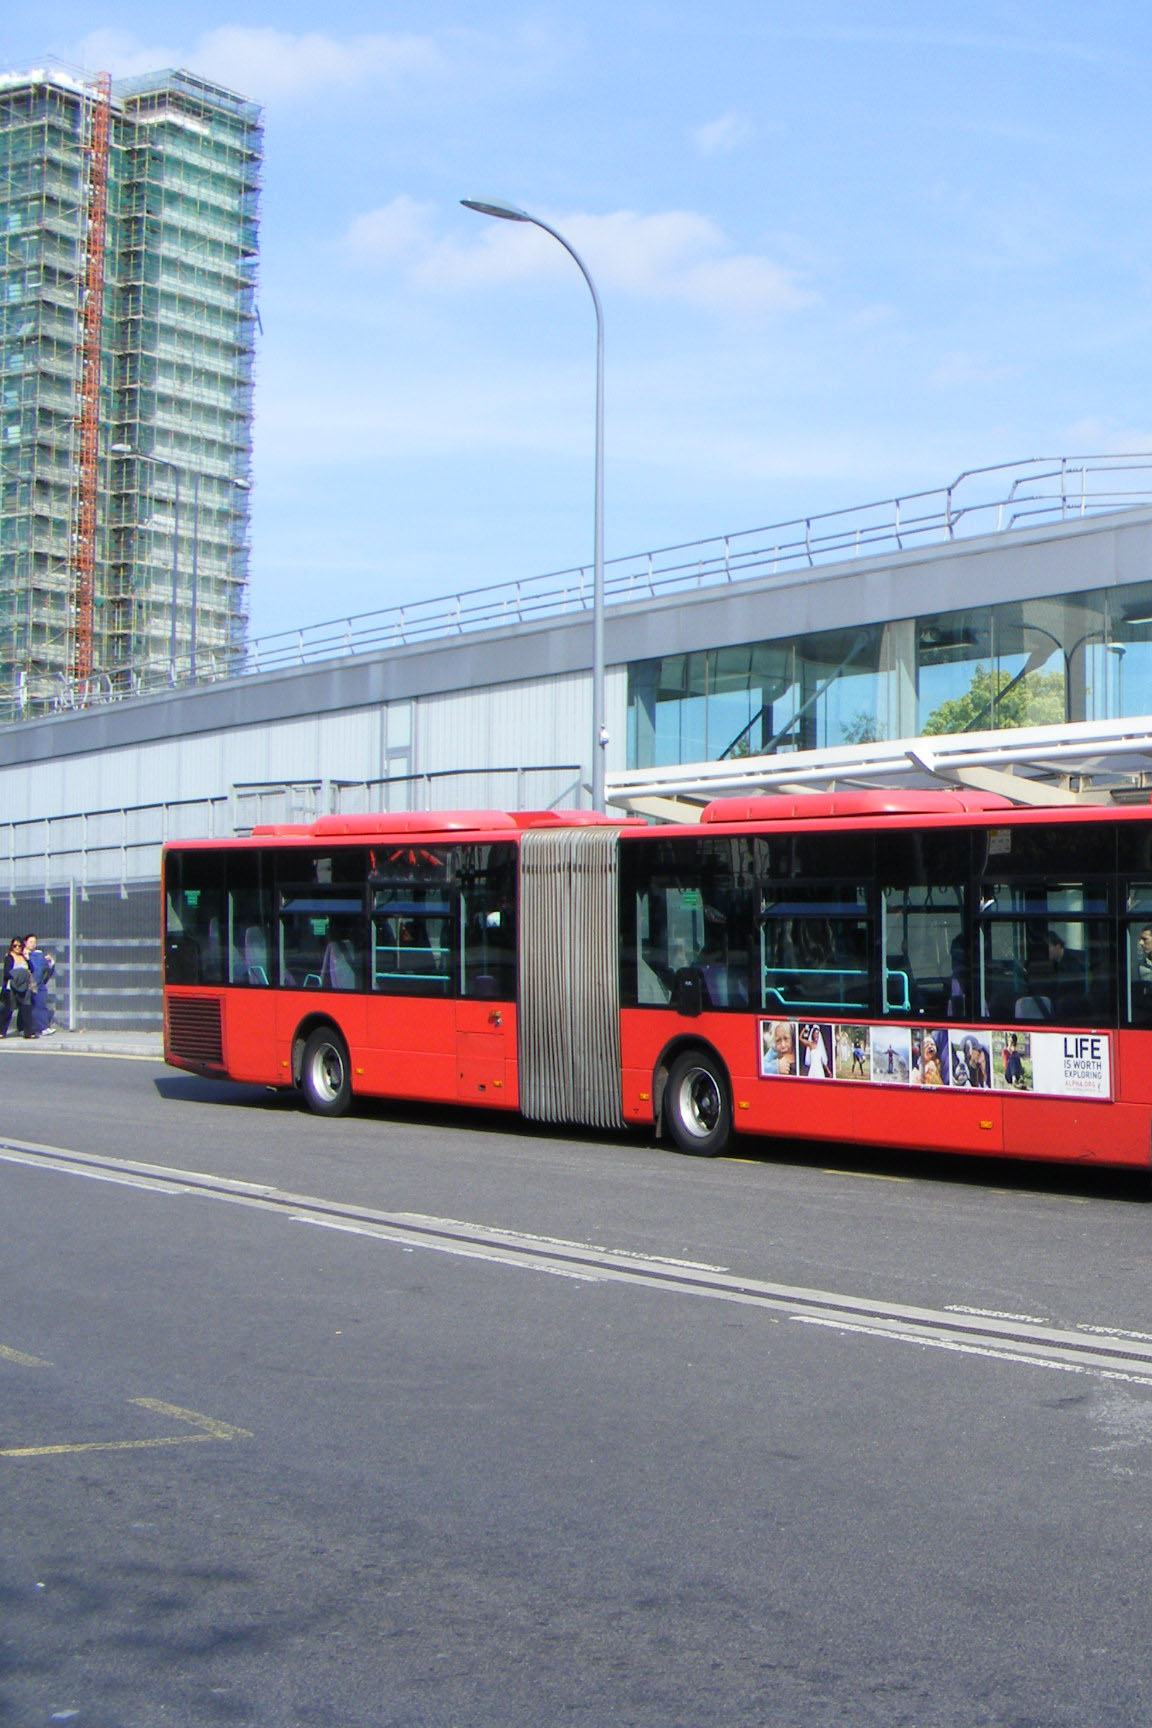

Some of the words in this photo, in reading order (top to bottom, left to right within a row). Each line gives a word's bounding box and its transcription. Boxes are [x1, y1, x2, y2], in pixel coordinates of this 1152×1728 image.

[1064, 1037, 1101, 1060] LIFE
[1064, 1060, 1072, 1069] IS
[1073, 1060, 1102, 1070] WORTH
[1064, 1070, 1102, 1080] EXPLORING
